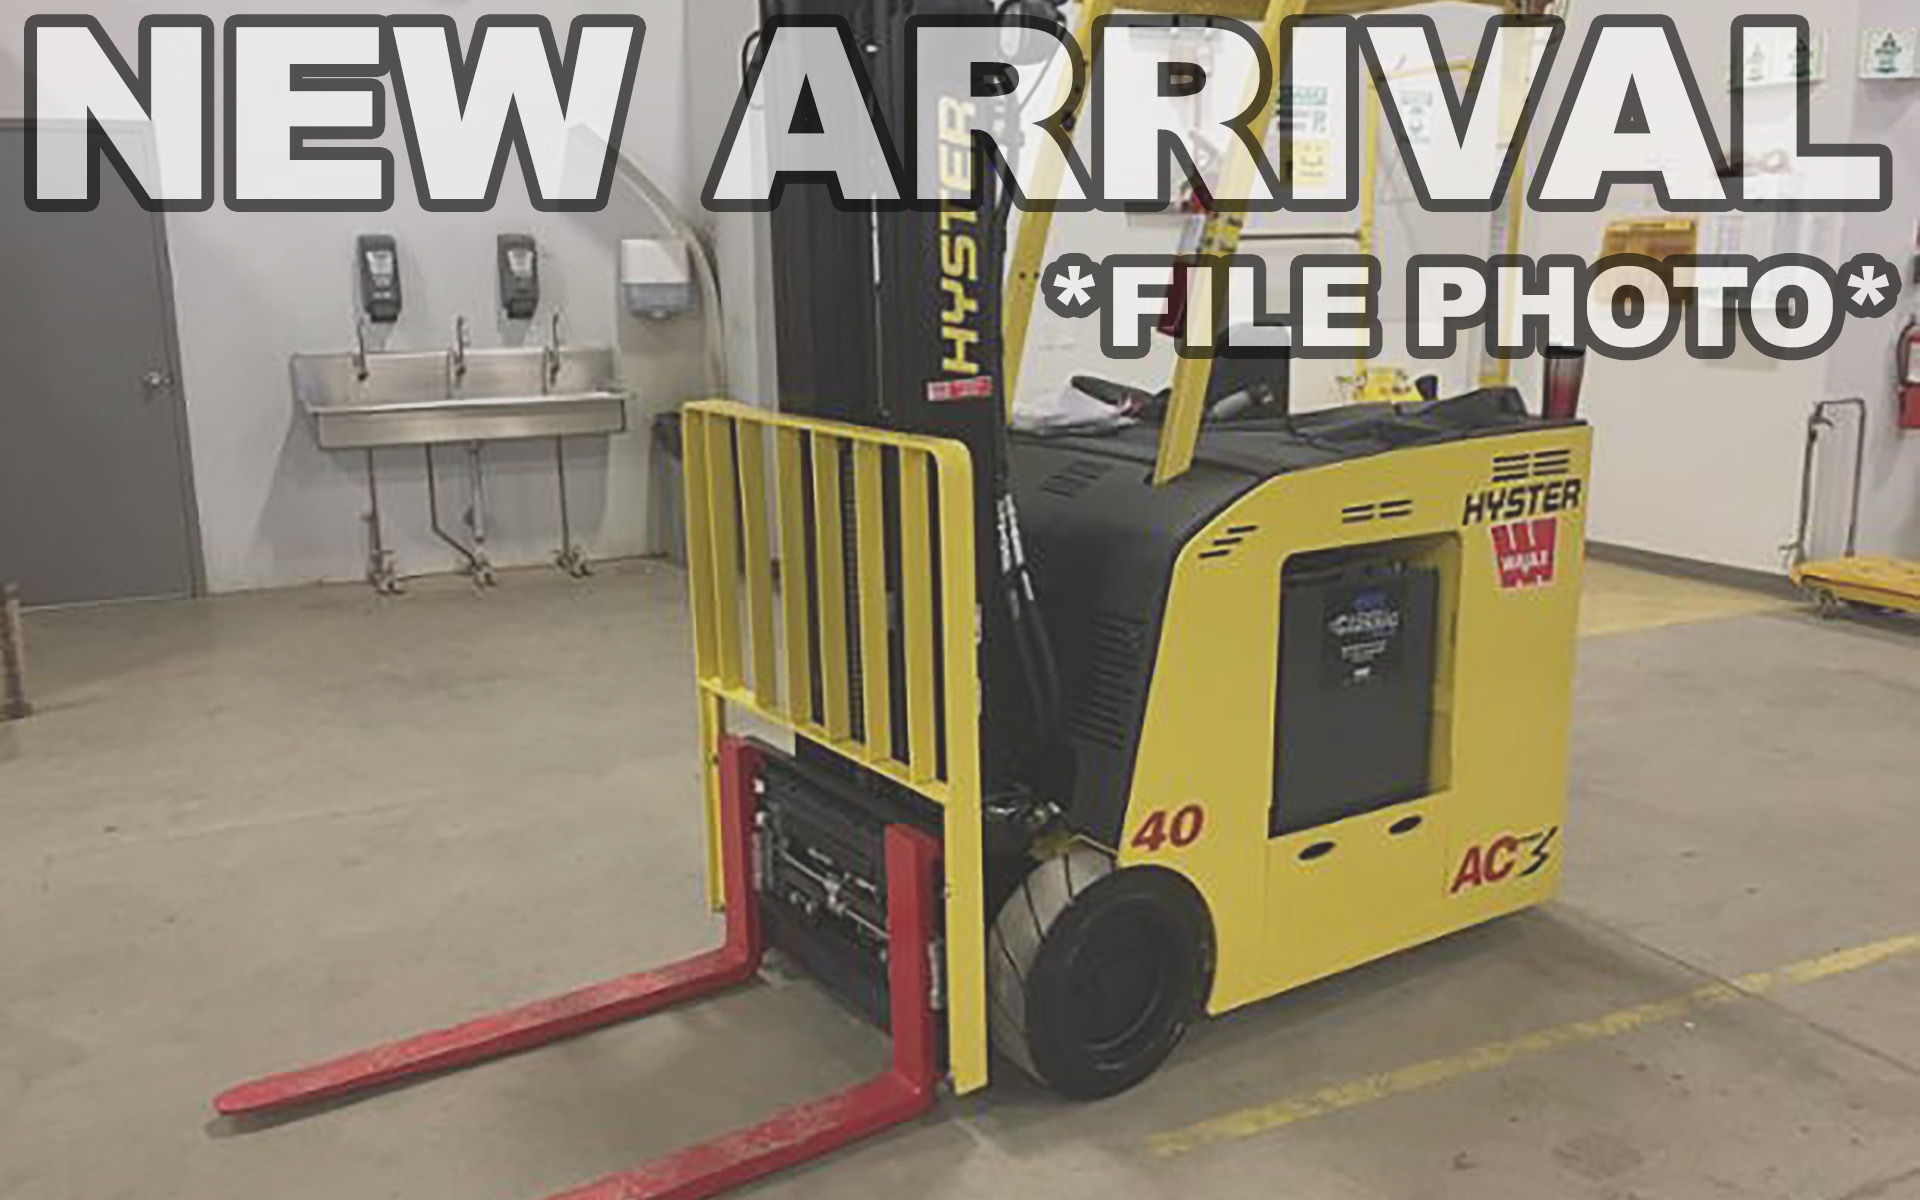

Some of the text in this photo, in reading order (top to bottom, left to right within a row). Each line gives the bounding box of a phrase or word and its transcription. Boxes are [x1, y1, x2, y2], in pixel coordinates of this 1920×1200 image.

[937, 95, 980, 375] HYSTER
[1462, 478, 1581, 526] HYSTER
[1131, 804, 1204, 851] 40
